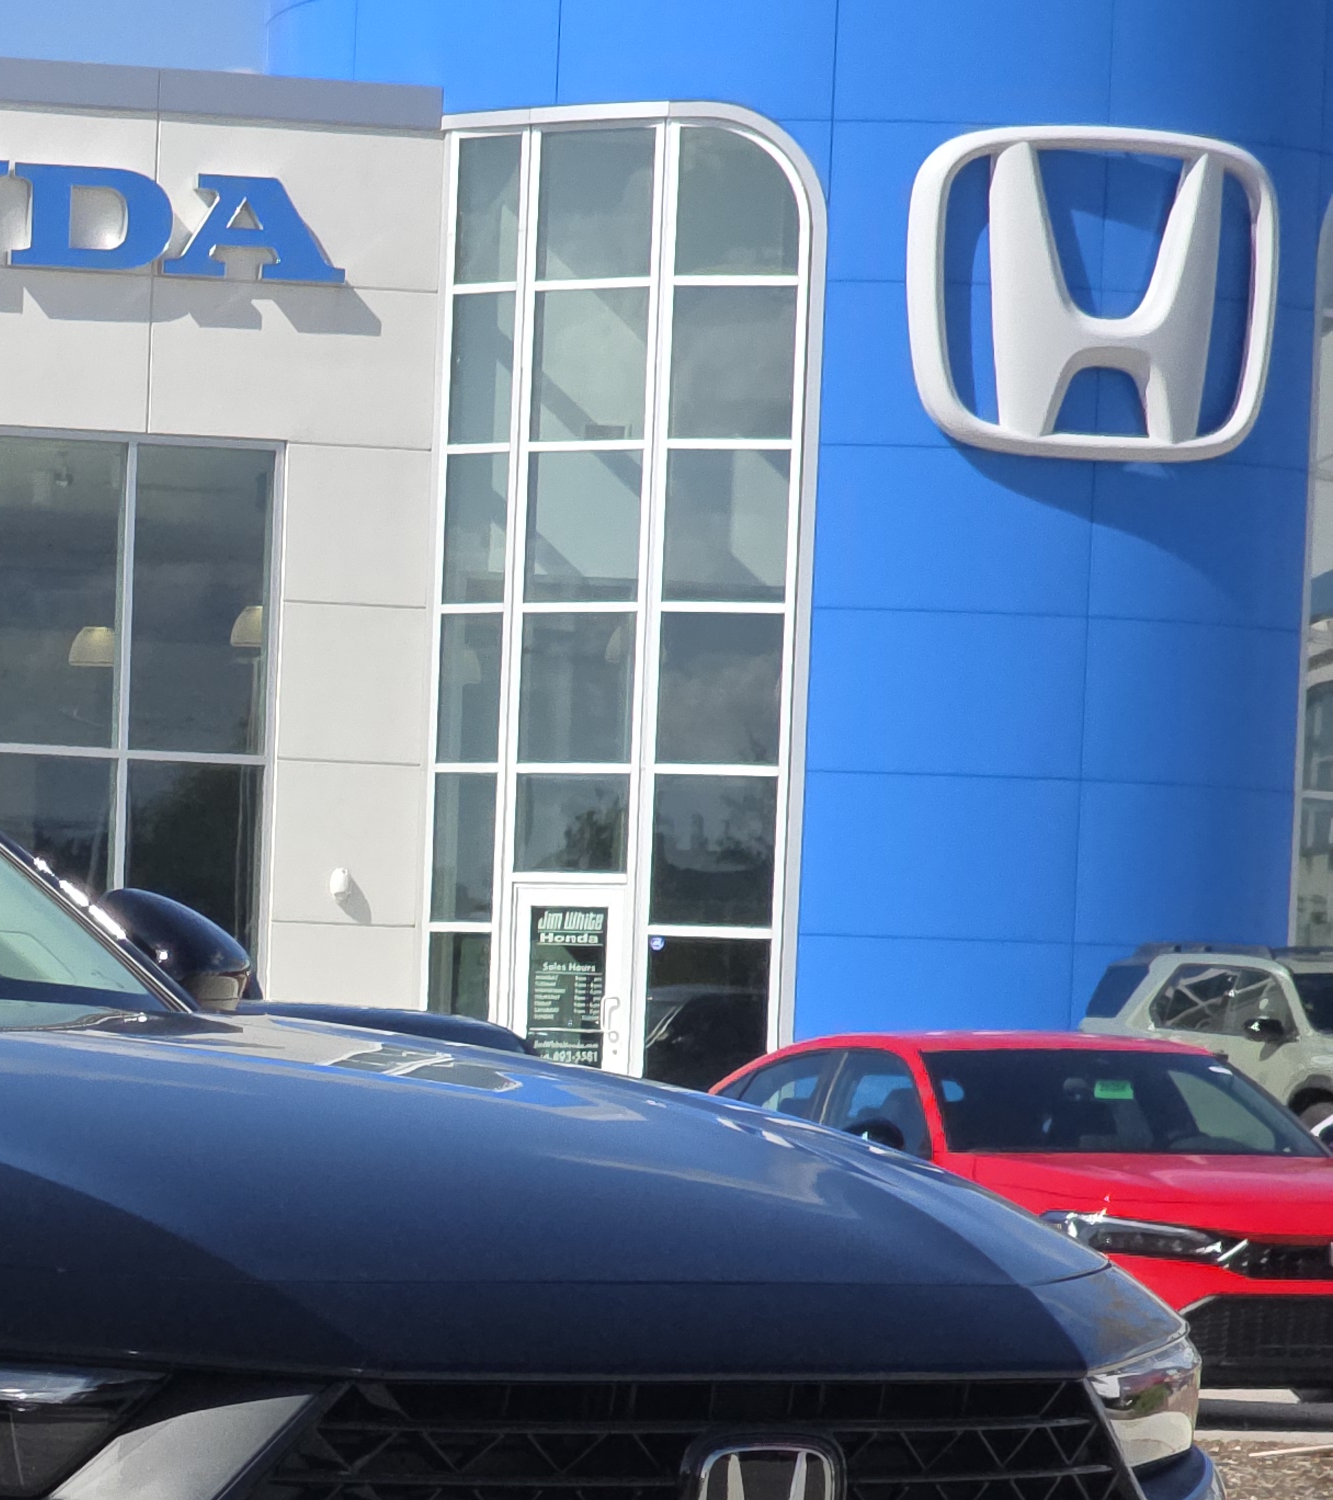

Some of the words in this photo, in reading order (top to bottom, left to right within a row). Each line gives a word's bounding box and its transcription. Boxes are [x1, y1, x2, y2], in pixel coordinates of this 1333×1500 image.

[537, 911, 563, 930] Jim
[539, 932, 599, 944] Honda
[542, 961, 567, 972] Sales
[568, 962, 596, 973] Hours
